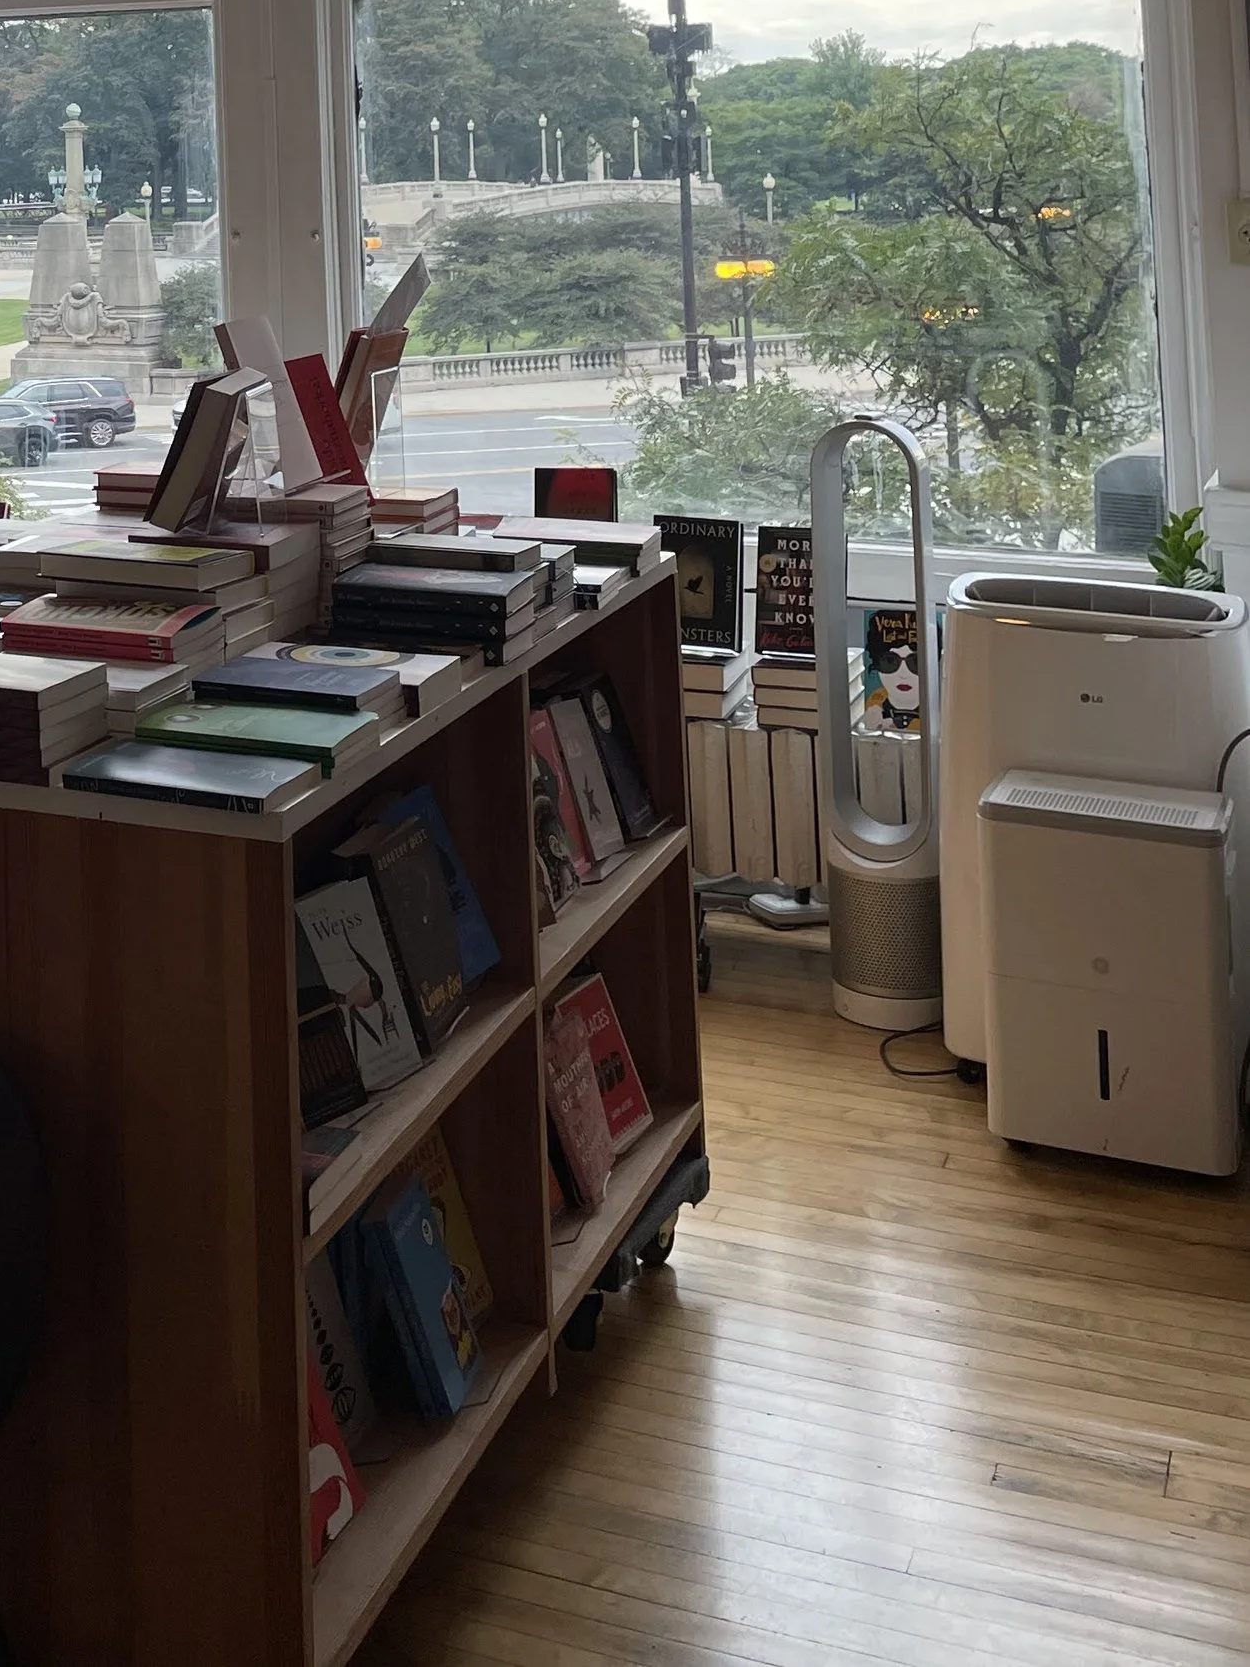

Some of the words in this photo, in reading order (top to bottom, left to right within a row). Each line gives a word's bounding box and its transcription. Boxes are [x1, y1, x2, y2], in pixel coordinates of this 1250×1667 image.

[659, 520, 736, 540] ORDINARY
[776, 539, 811, 552] MOR
[778, 558, 813, 570] THA
[680, 627, 732, 644] NSTERS
[312, 910, 364, 941] Weiss
